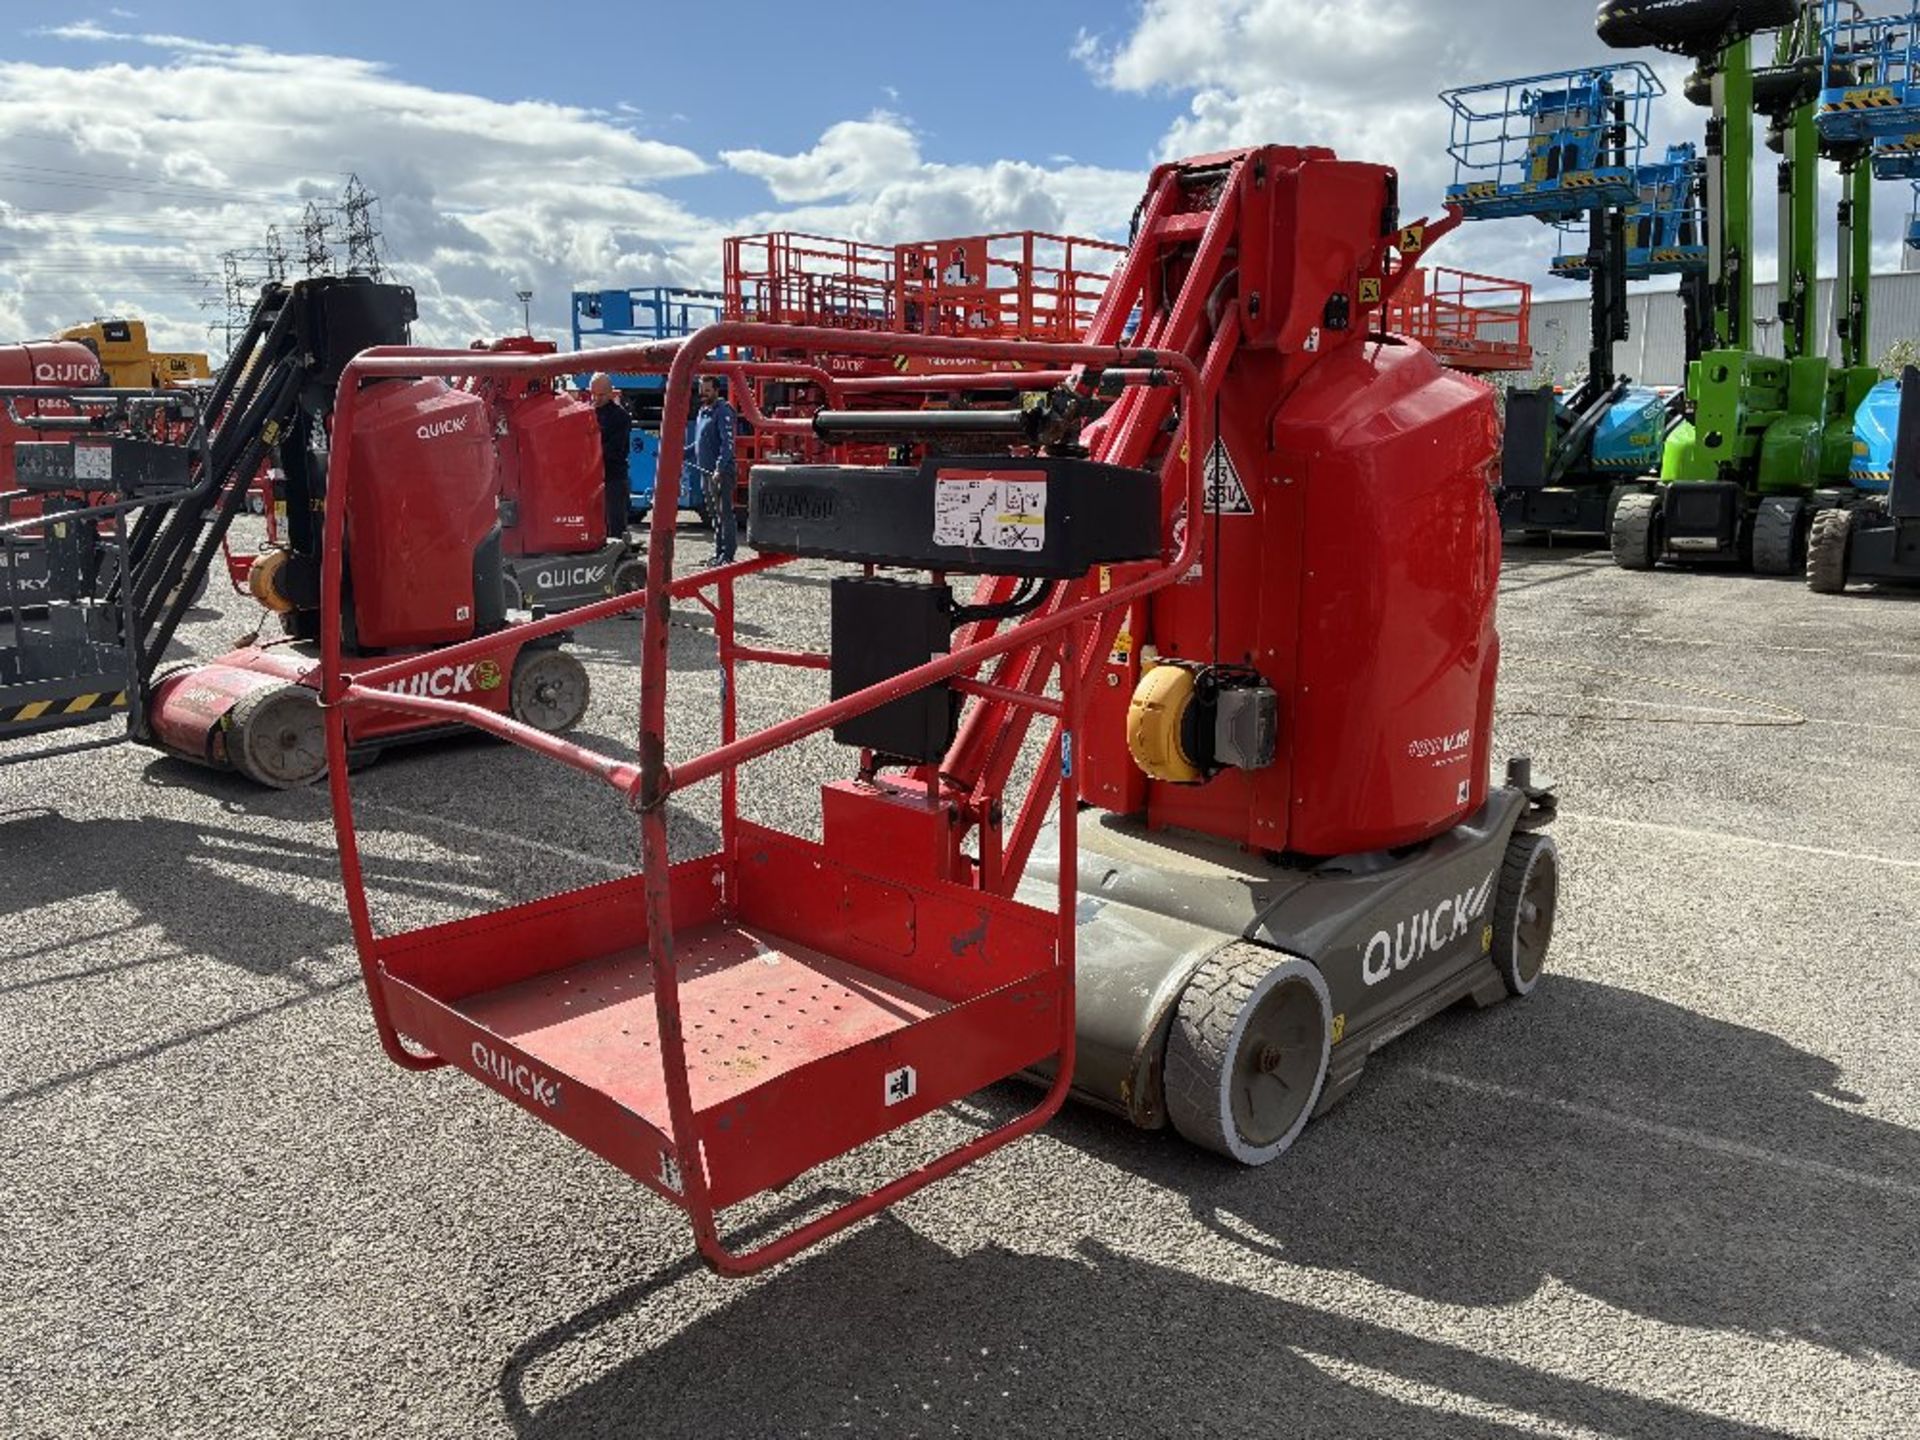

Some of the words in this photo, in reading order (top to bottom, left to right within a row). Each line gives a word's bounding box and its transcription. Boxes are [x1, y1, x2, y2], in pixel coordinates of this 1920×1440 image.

[416, 416, 465, 439] QUICK
[537, 565, 601, 588] QUICK
[386, 663, 475, 699] UICK
[1362, 886, 1476, 986] QUICK
[471, 1041, 552, 1109] QUICK
